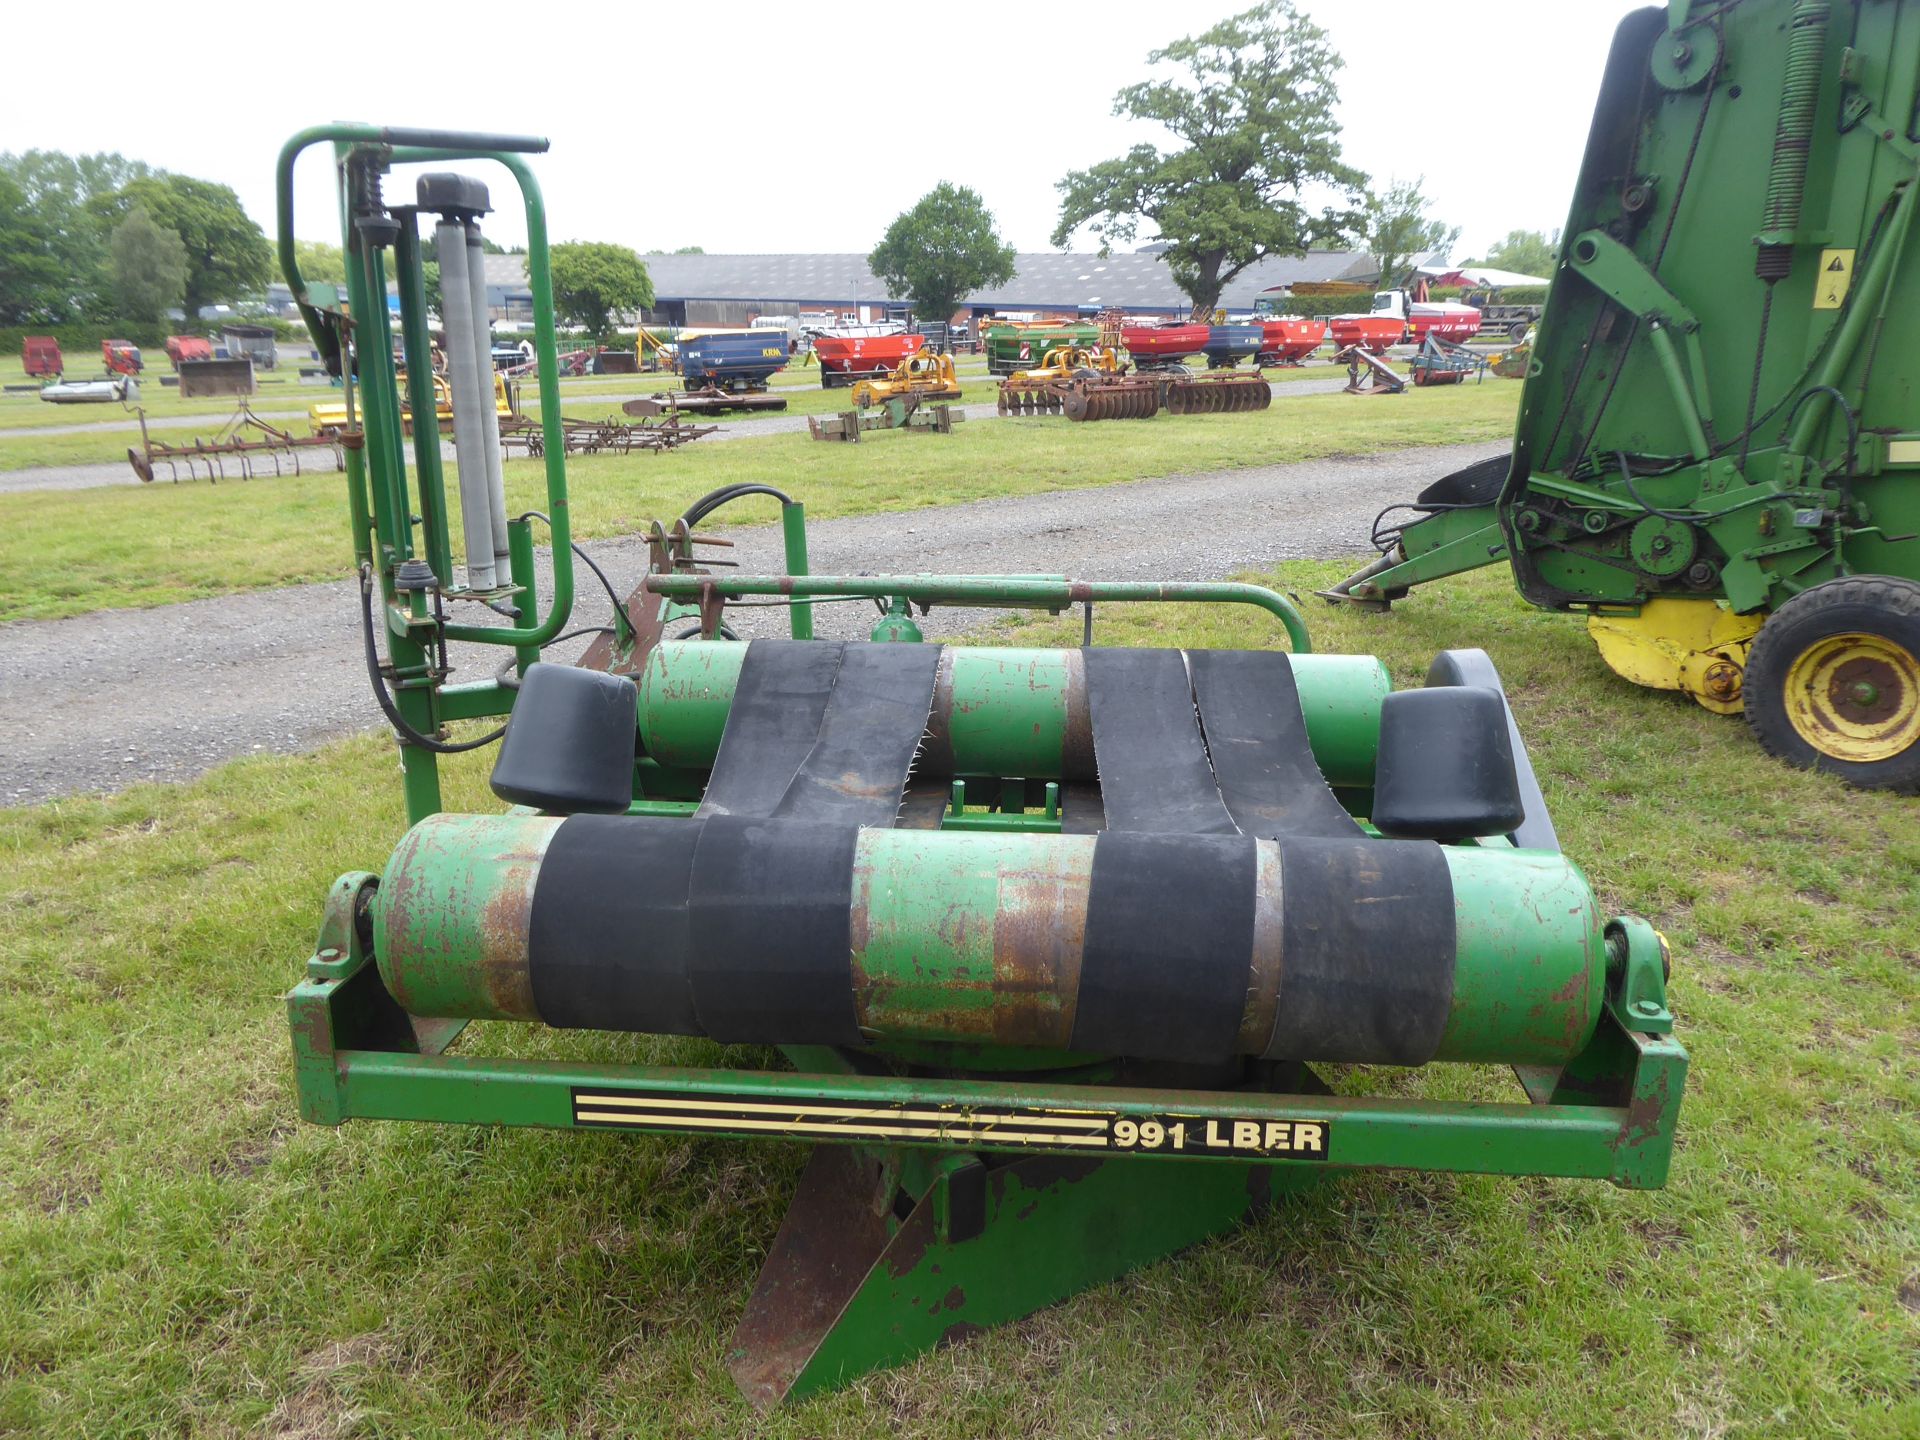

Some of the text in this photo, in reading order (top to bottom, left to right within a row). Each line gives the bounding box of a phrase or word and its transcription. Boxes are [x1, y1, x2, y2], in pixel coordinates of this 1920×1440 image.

[763, 348, 782, 358] KRM
[1114, 1120, 1322, 1152] 991 LBER
